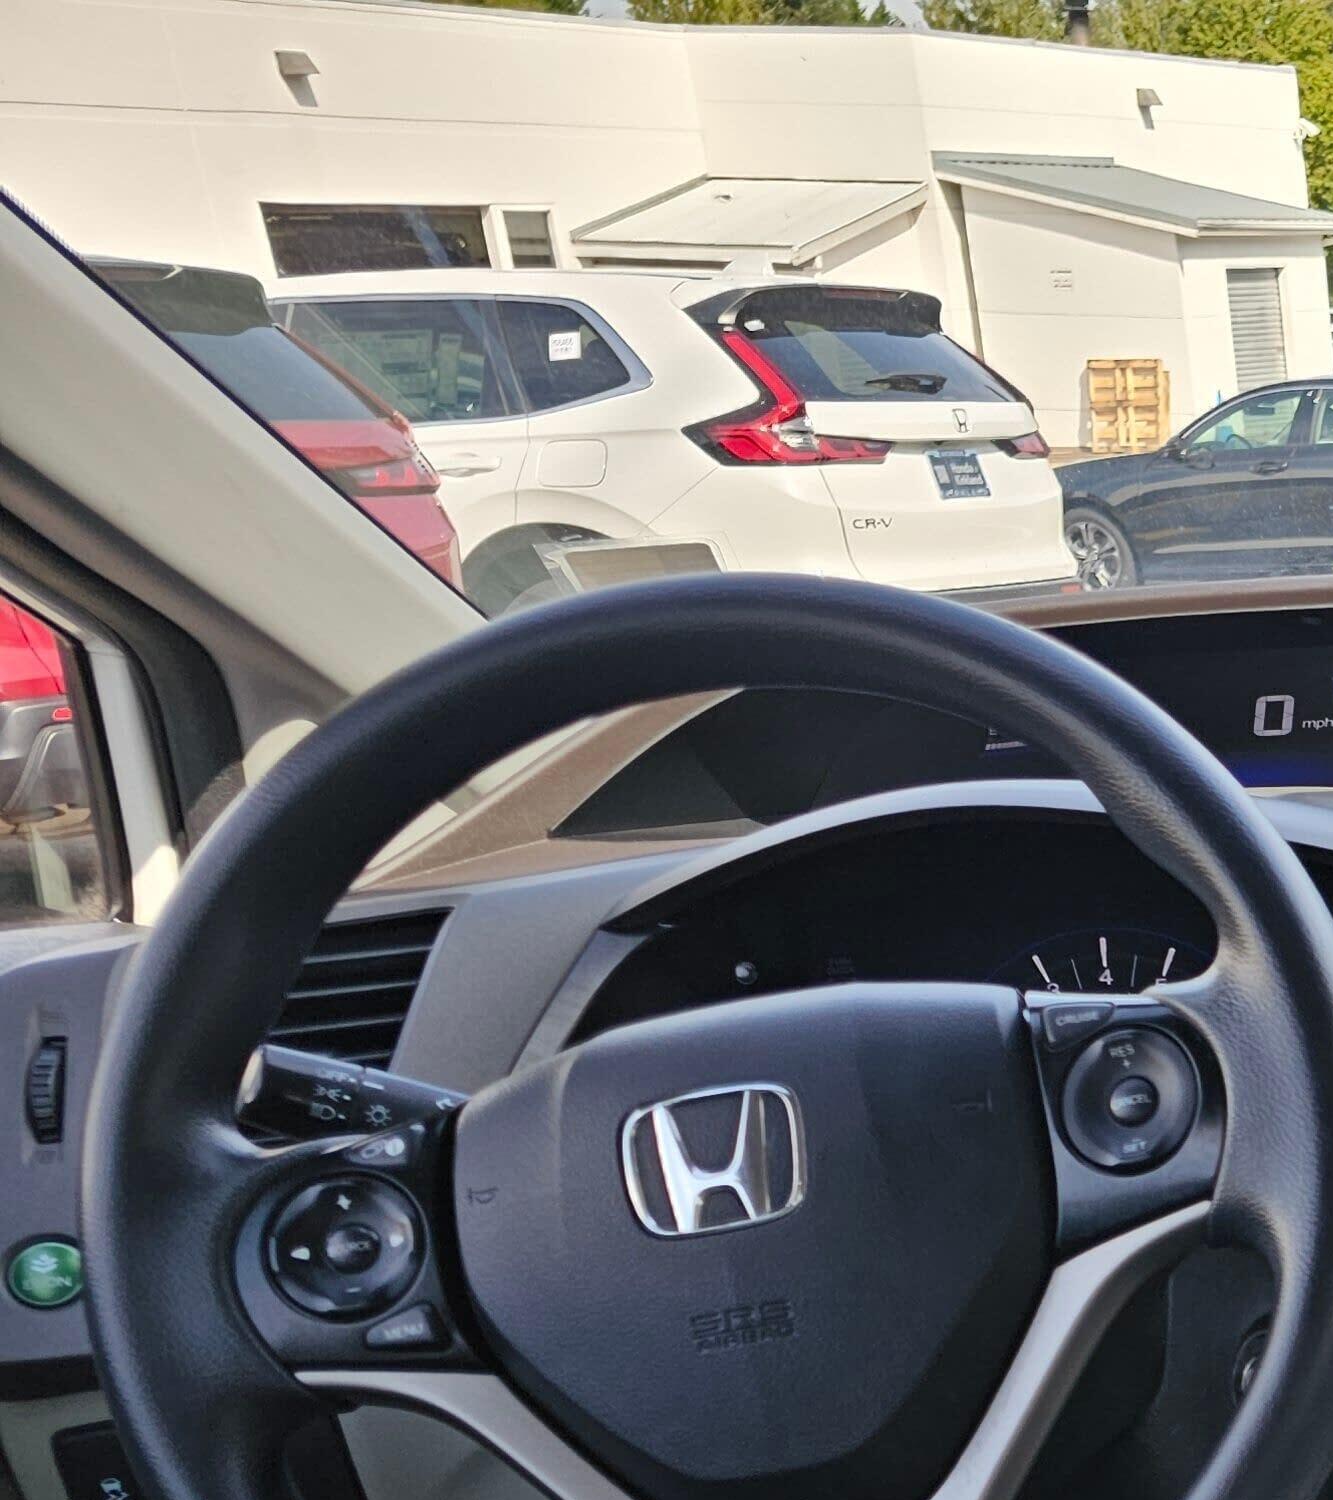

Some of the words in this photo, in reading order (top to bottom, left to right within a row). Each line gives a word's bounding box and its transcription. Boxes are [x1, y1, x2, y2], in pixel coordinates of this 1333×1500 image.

[852, 517, 893, 530] CR-V
[1253, 694, 1295, 737] 0
[1302, 717, 1333, 731] mph
[1098, 968, 1114, 986] 4
